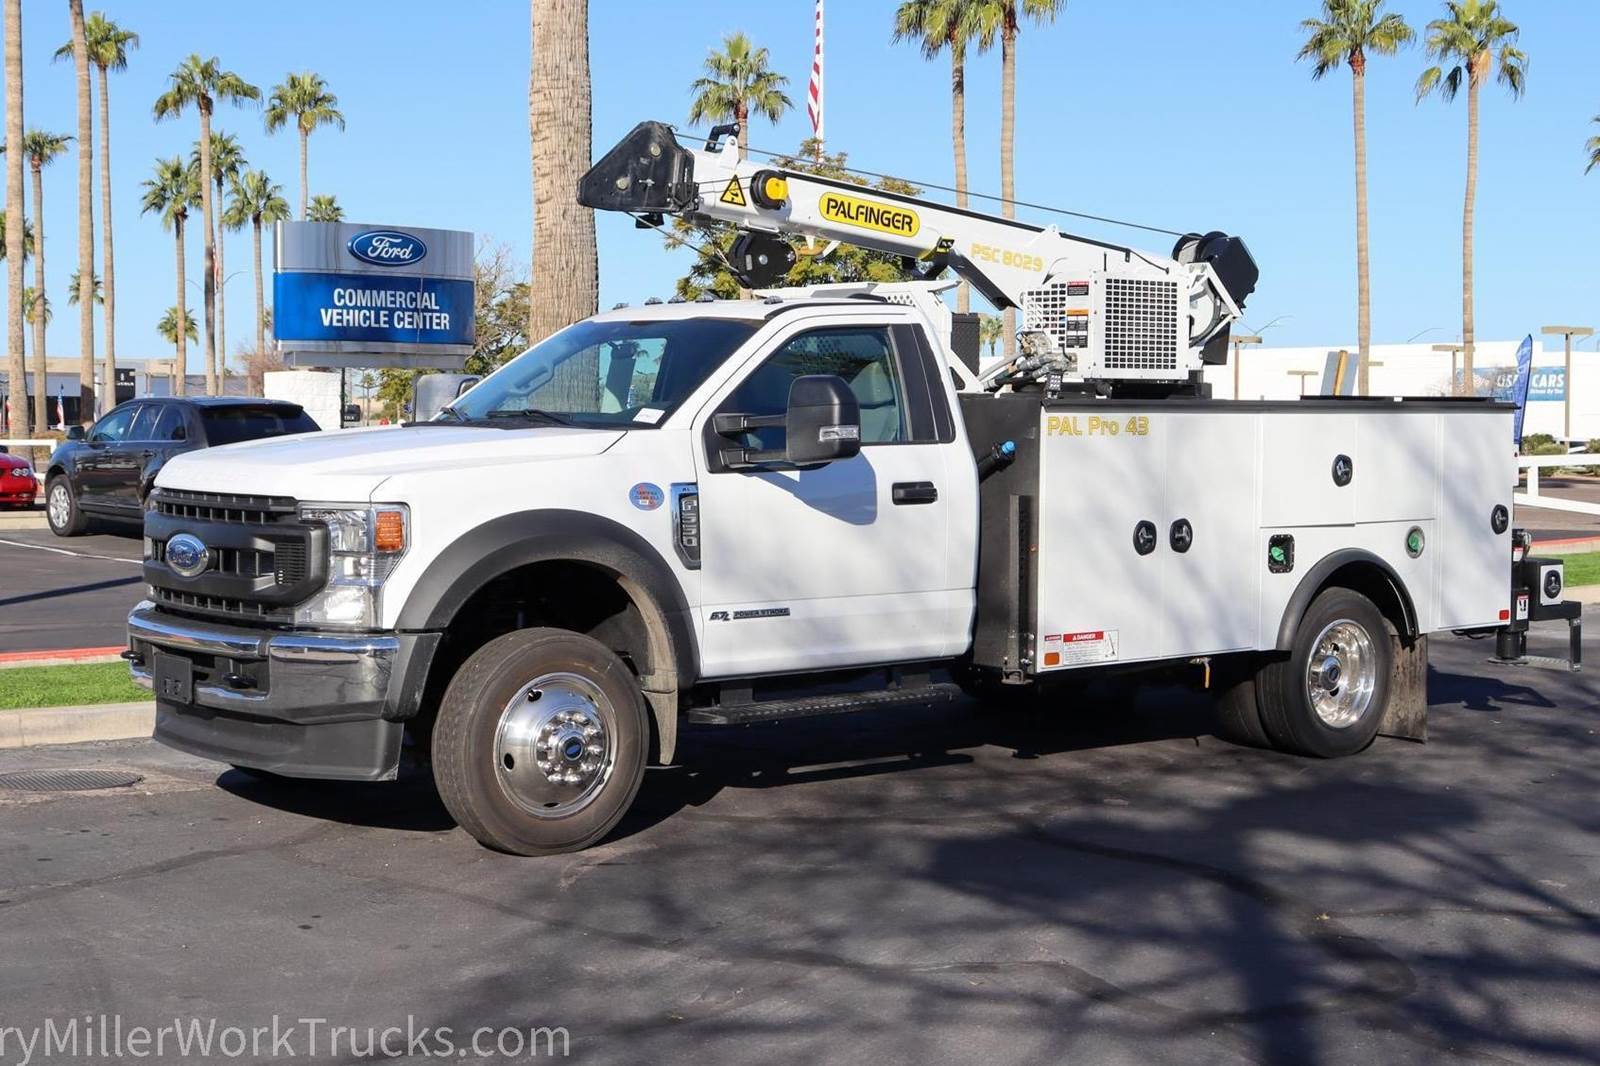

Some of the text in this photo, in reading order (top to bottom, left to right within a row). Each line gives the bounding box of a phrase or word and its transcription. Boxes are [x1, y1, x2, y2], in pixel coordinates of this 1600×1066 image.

[826, 198, 913, 232] PALFINGER
[367, 235, 413, 260] Ford
[971, 243, 1043, 272] PSC 8029
[333, 288, 440, 310] COMMERCIAL
[320, 308, 450, 330] VEHICLE CENTER
[1531, 374, 1565, 388] CARS
[1048, 416, 1150, 436] PAL Pro 43
